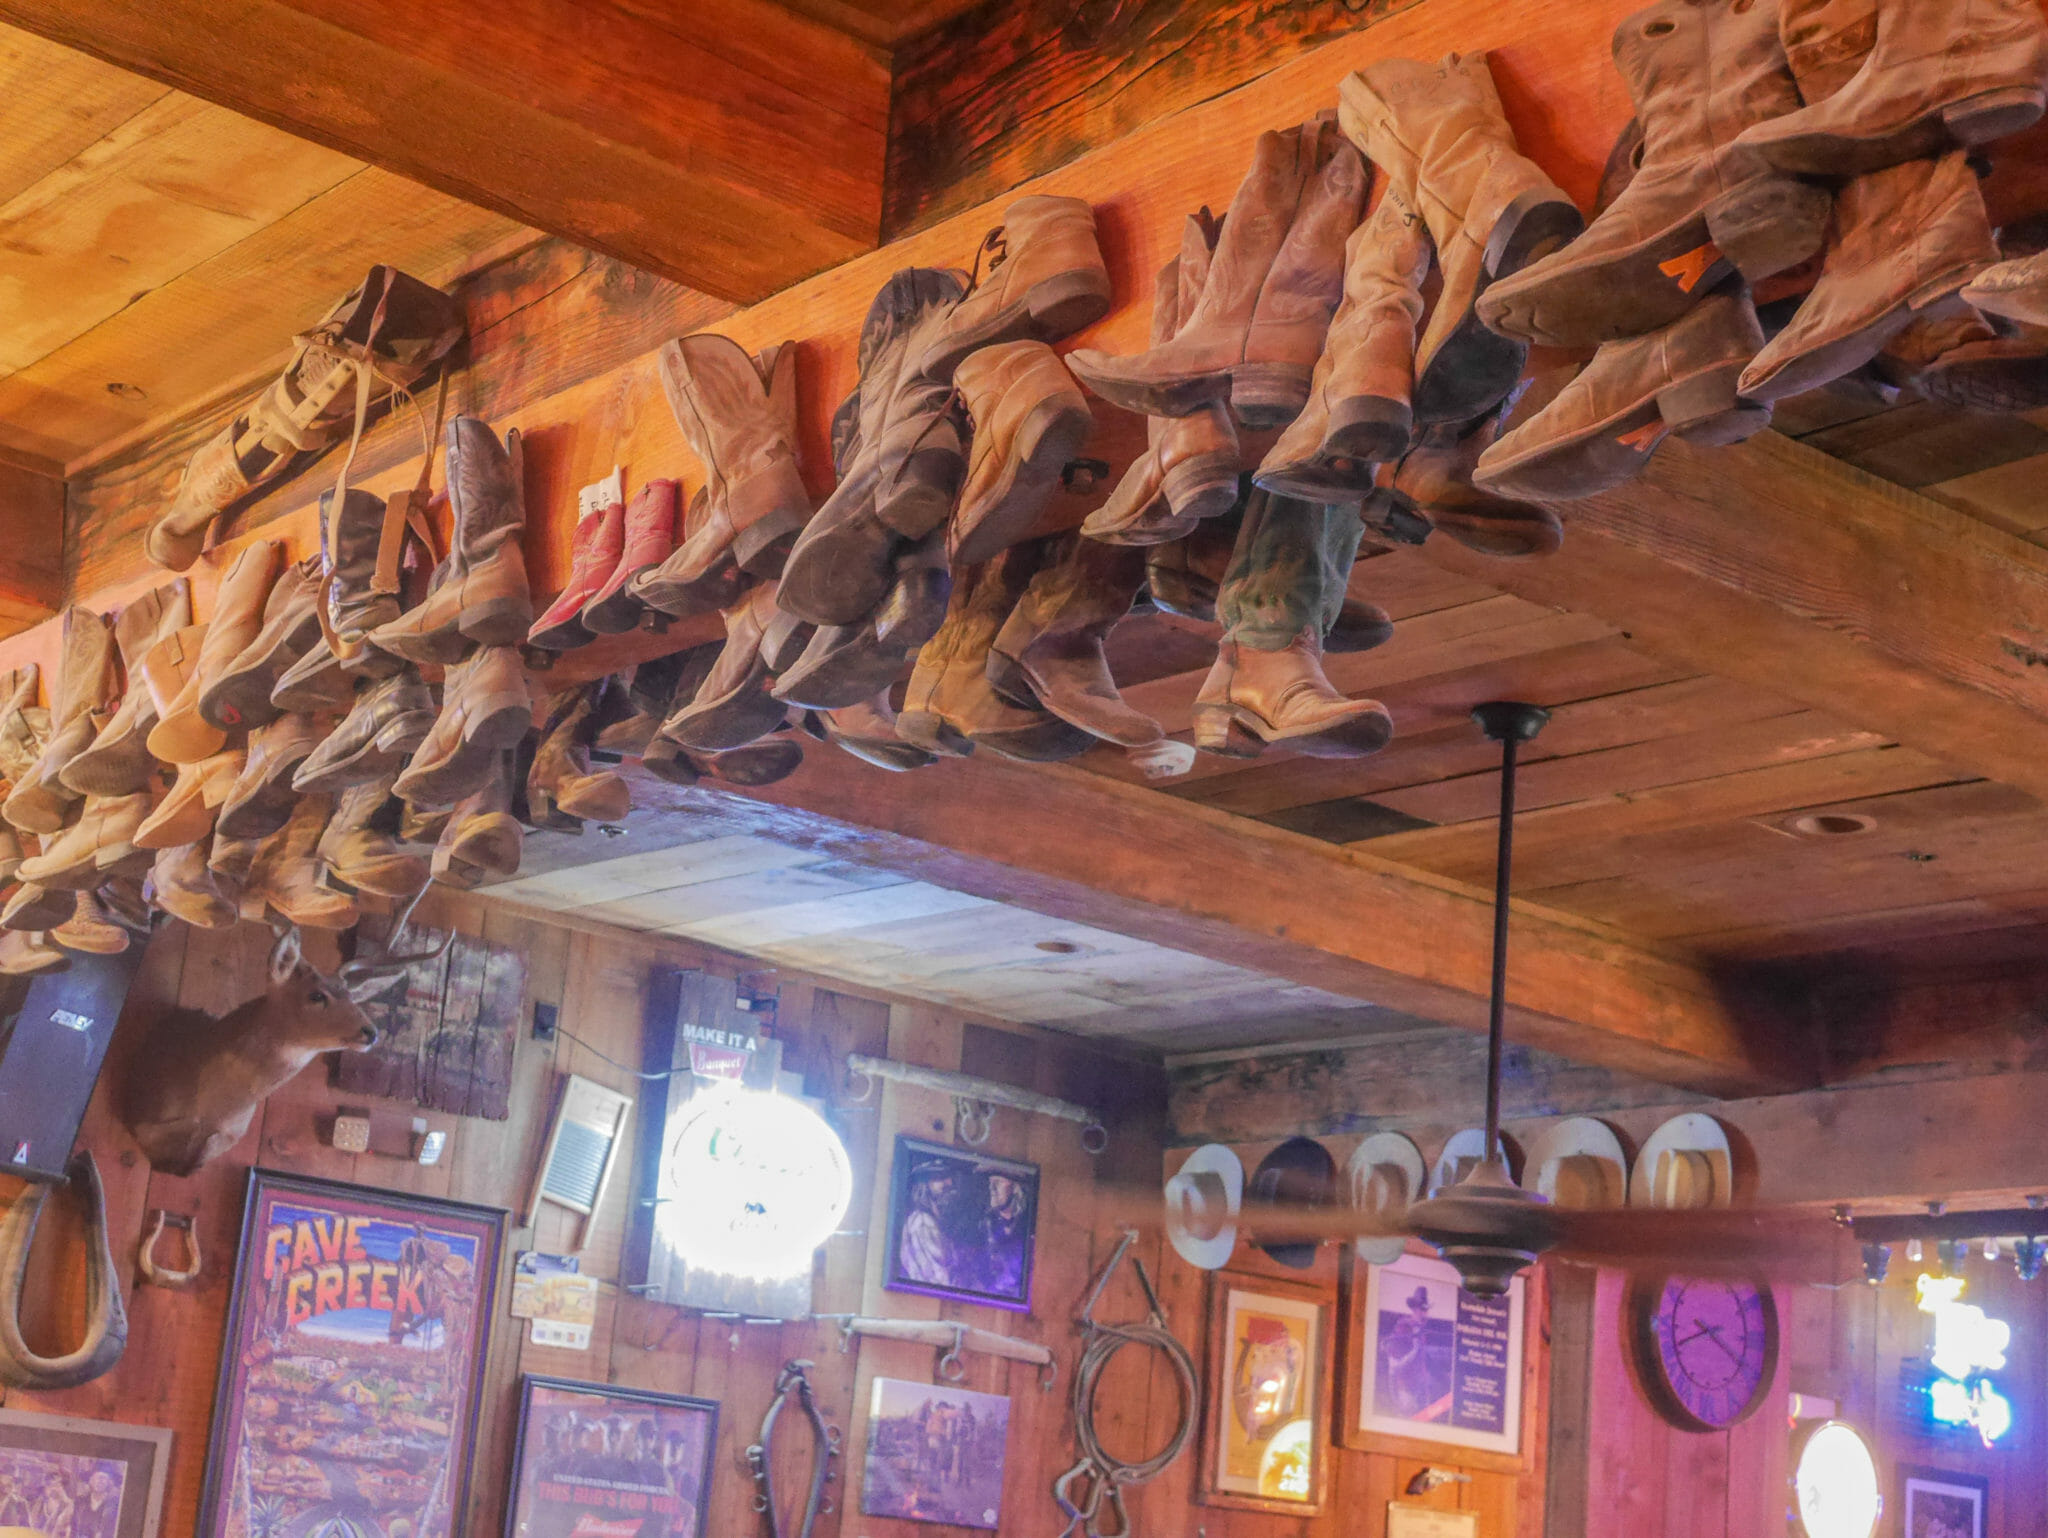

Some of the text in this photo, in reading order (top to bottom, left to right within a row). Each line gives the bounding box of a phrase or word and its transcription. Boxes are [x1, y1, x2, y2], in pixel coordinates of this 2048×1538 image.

[683, 1024, 756, 1051] MAKE IT A
[698, 1050, 741, 1073] Banquet
[264, 1216, 370, 1279] CAVE
[287, 1260, 424, 1325] CREEK
